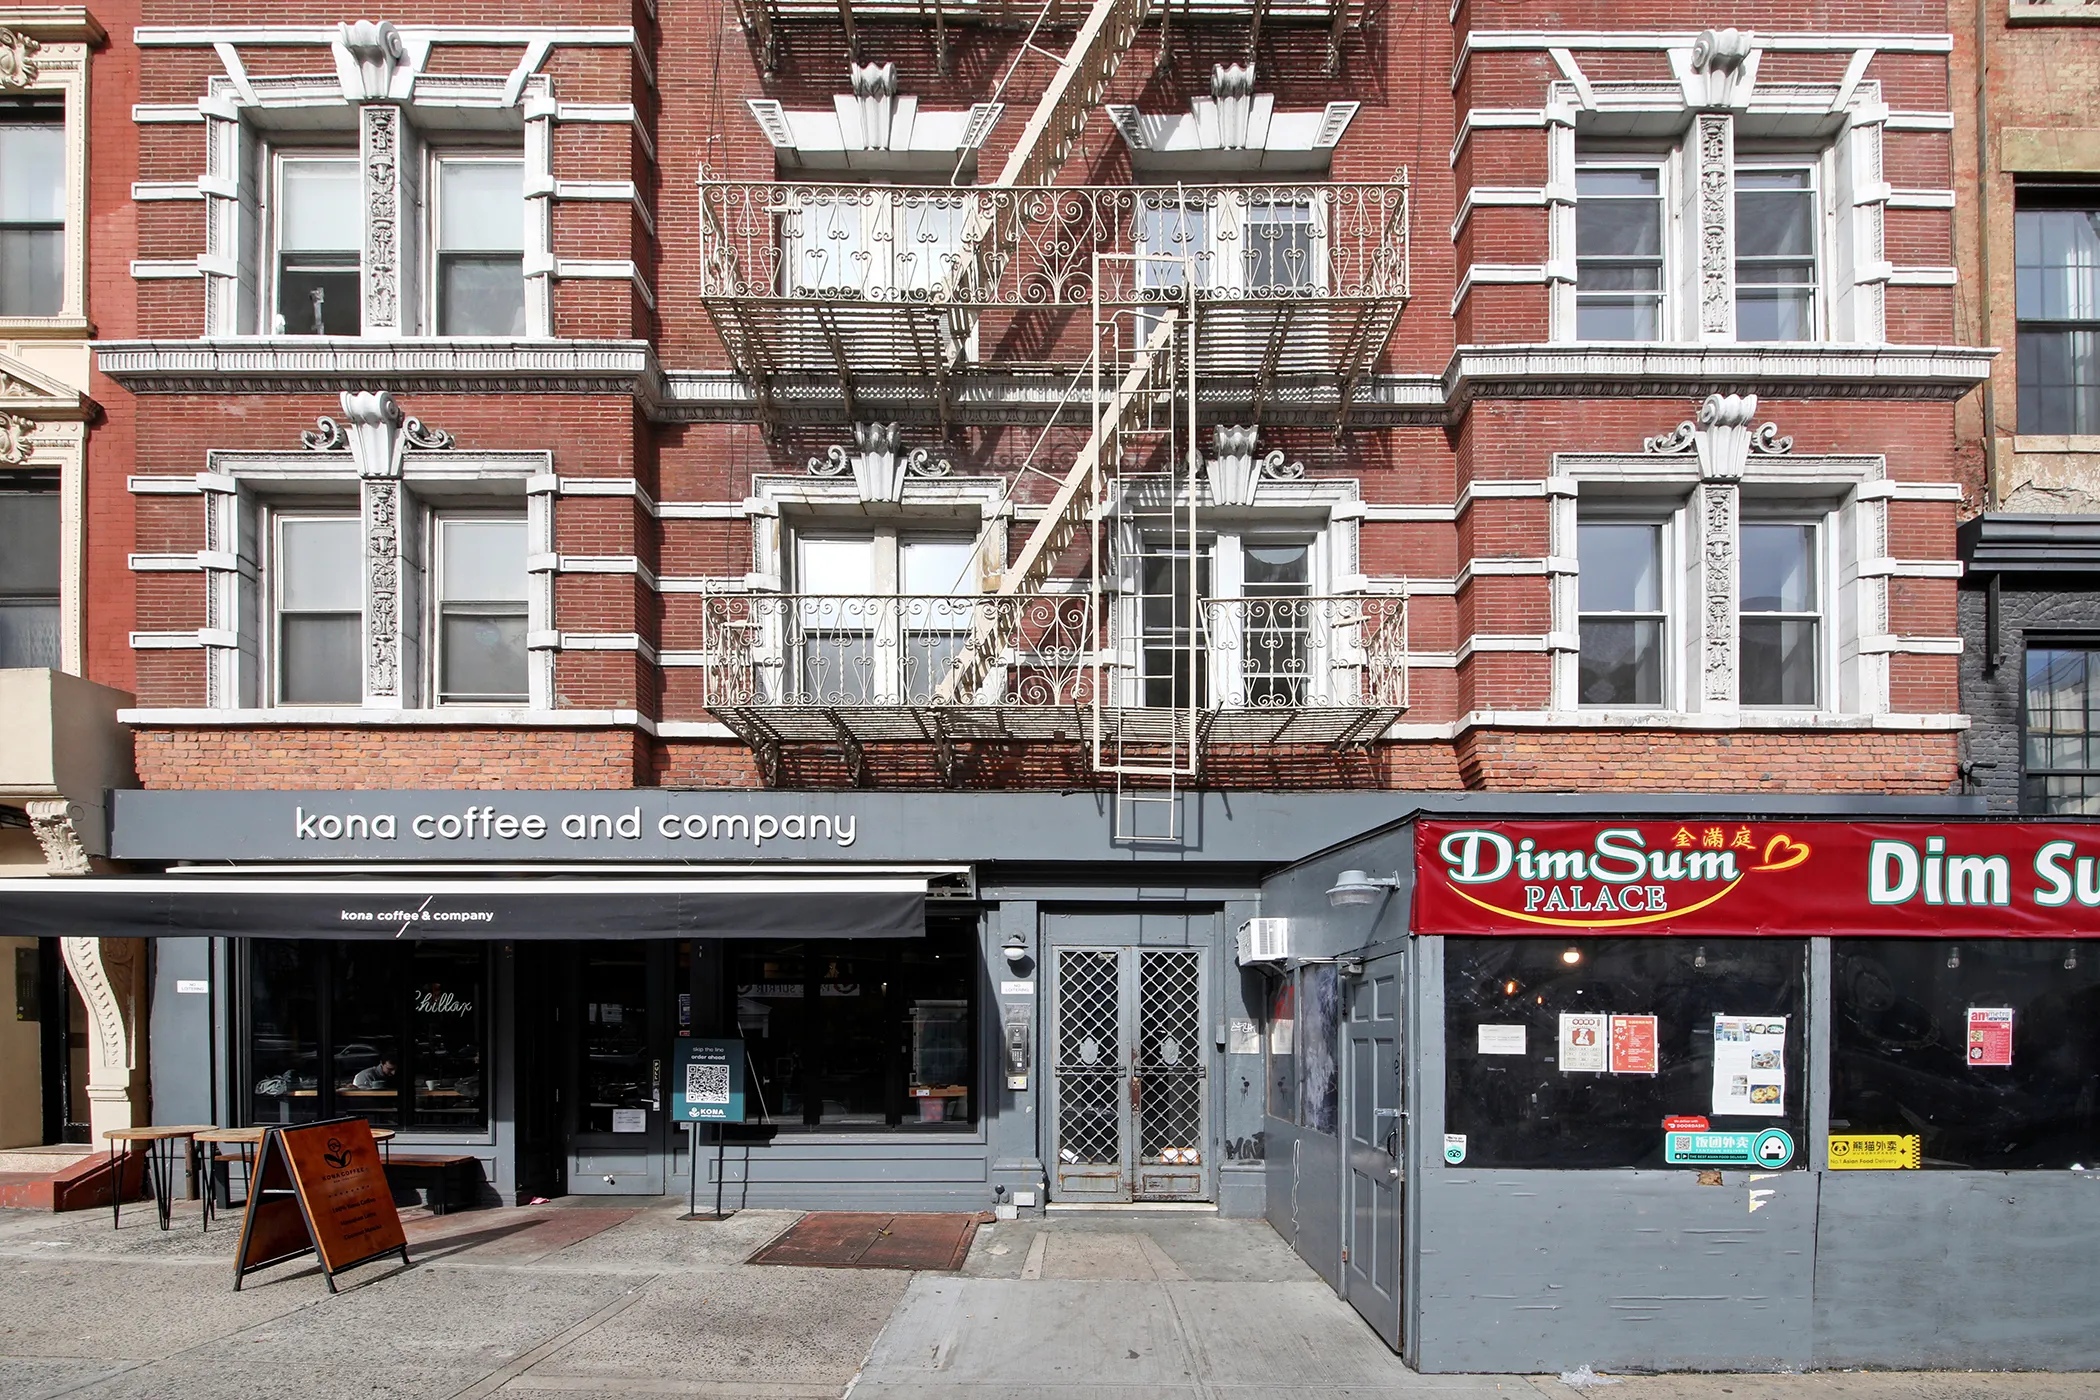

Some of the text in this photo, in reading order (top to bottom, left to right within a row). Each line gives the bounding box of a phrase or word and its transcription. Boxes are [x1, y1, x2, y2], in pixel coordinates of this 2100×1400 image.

[296, 806, 857, 846] kona coffee and company
[1671, 825, 1756, 850] 金滿庭
[1868, 836, 2010, 905] Dim
[1524, 885, 1667, 911] PALACE
[341, 910, 494, 922] kona coffee & company
[1696, 1136, 1749, 1148] 饭团外卖
[1853, 1141, 1897, 1151] 熊猫外卖
[322, 1172, 340, 1181] KONA
[341, 1167, 364, 1177] COFFEE
